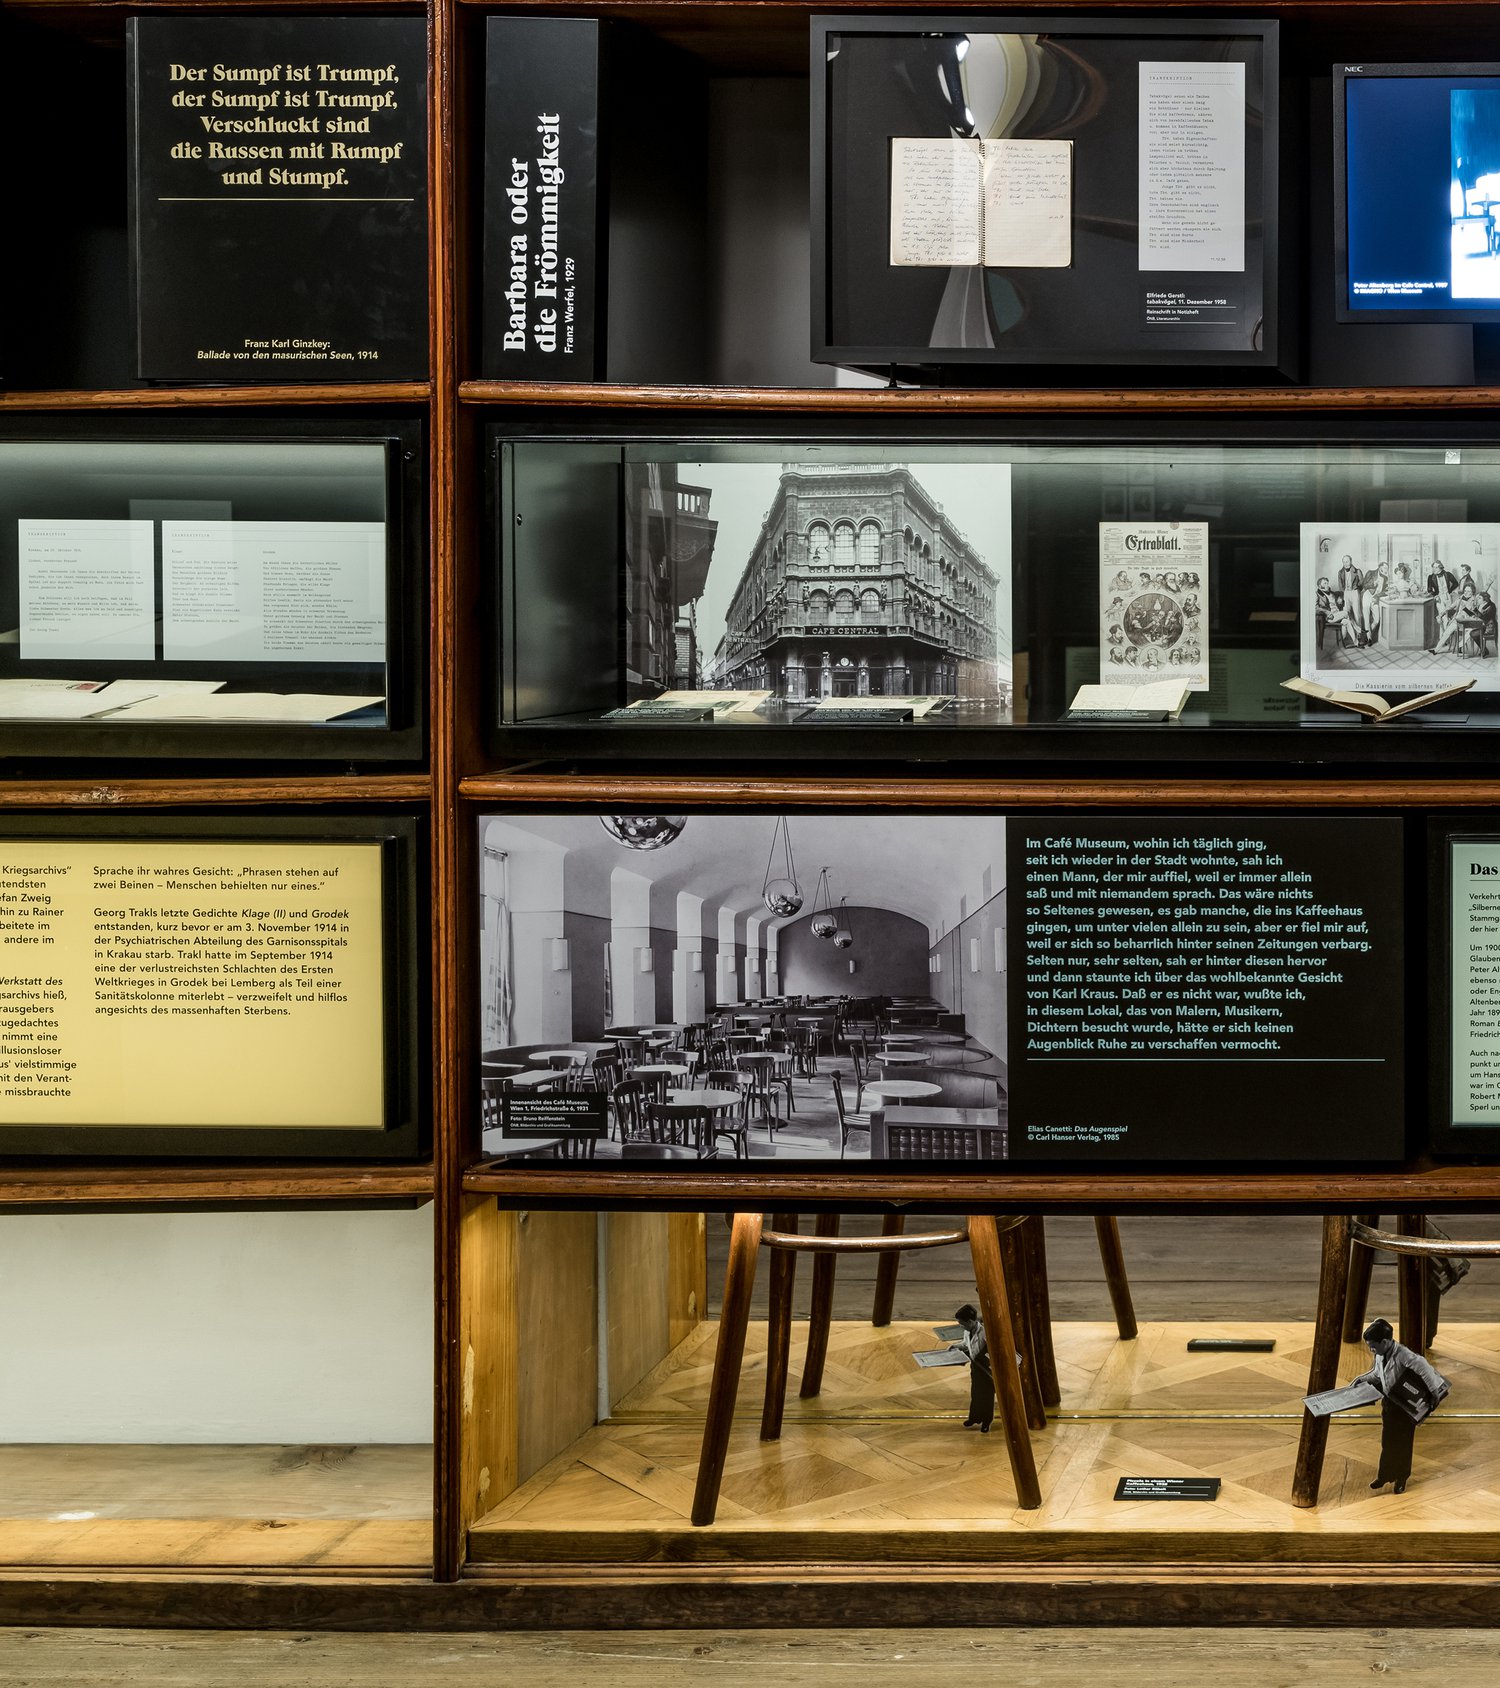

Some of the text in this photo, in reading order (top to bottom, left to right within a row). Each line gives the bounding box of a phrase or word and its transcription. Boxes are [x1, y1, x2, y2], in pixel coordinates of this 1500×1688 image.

[170, 64, 399, 84] Der Sumpf ist Trumpf,
[172, 90, 397, 110] der Sumpf ist Trumpf,
[200, 116, 370, 133] Verschluckt sind
[171, 142, 403, 162] die Russen mit Rumpf
[221, 168, 349, 188] und Stumpf.
[535, 112, 565, 353] die Frömmigkeit
[503, 157, 528, 352] Barbara oder
[565, 257, 575, 353] Franz Werfel, 1929
[245, 339, 330, 349] Franz Karl Ginzkey:
[197, 350, 231, 359] Ballade
[252, 350, 270, 359] den
[272, 349, 327, 359] masurischen
[330, 351, 354, 360] Seen,
[357, 351, 378, 359] 1914
[838, 627, 880, 635] CENTRAL
[1026, 837, 1267, 851] Im Café Museum, wohin ich täglich ging,
[1026, 854, 1283, 866] seit ich wieder in der Stadt wohnte, sah ich
[2, 865, 72, 877] Kriegsarchivs“
[93, 866, 339, 877] Sprache ihr wahres Gesicht: „Phrasen stehen auf
[1470, 863, 1498, 875] Das
[1026, 871, 1312, 883] einen Mann, der mir auffiel, weil er immer allein
[1026, 887, 1313, 901] saß und mit niemandem sprach. Das wäre nichts
[1027, 1038, 1281, 1052] Augenblick Ruhe zu verschaffen vermocht.
[1089, 1125, 1128, 1133] Augenspiel
